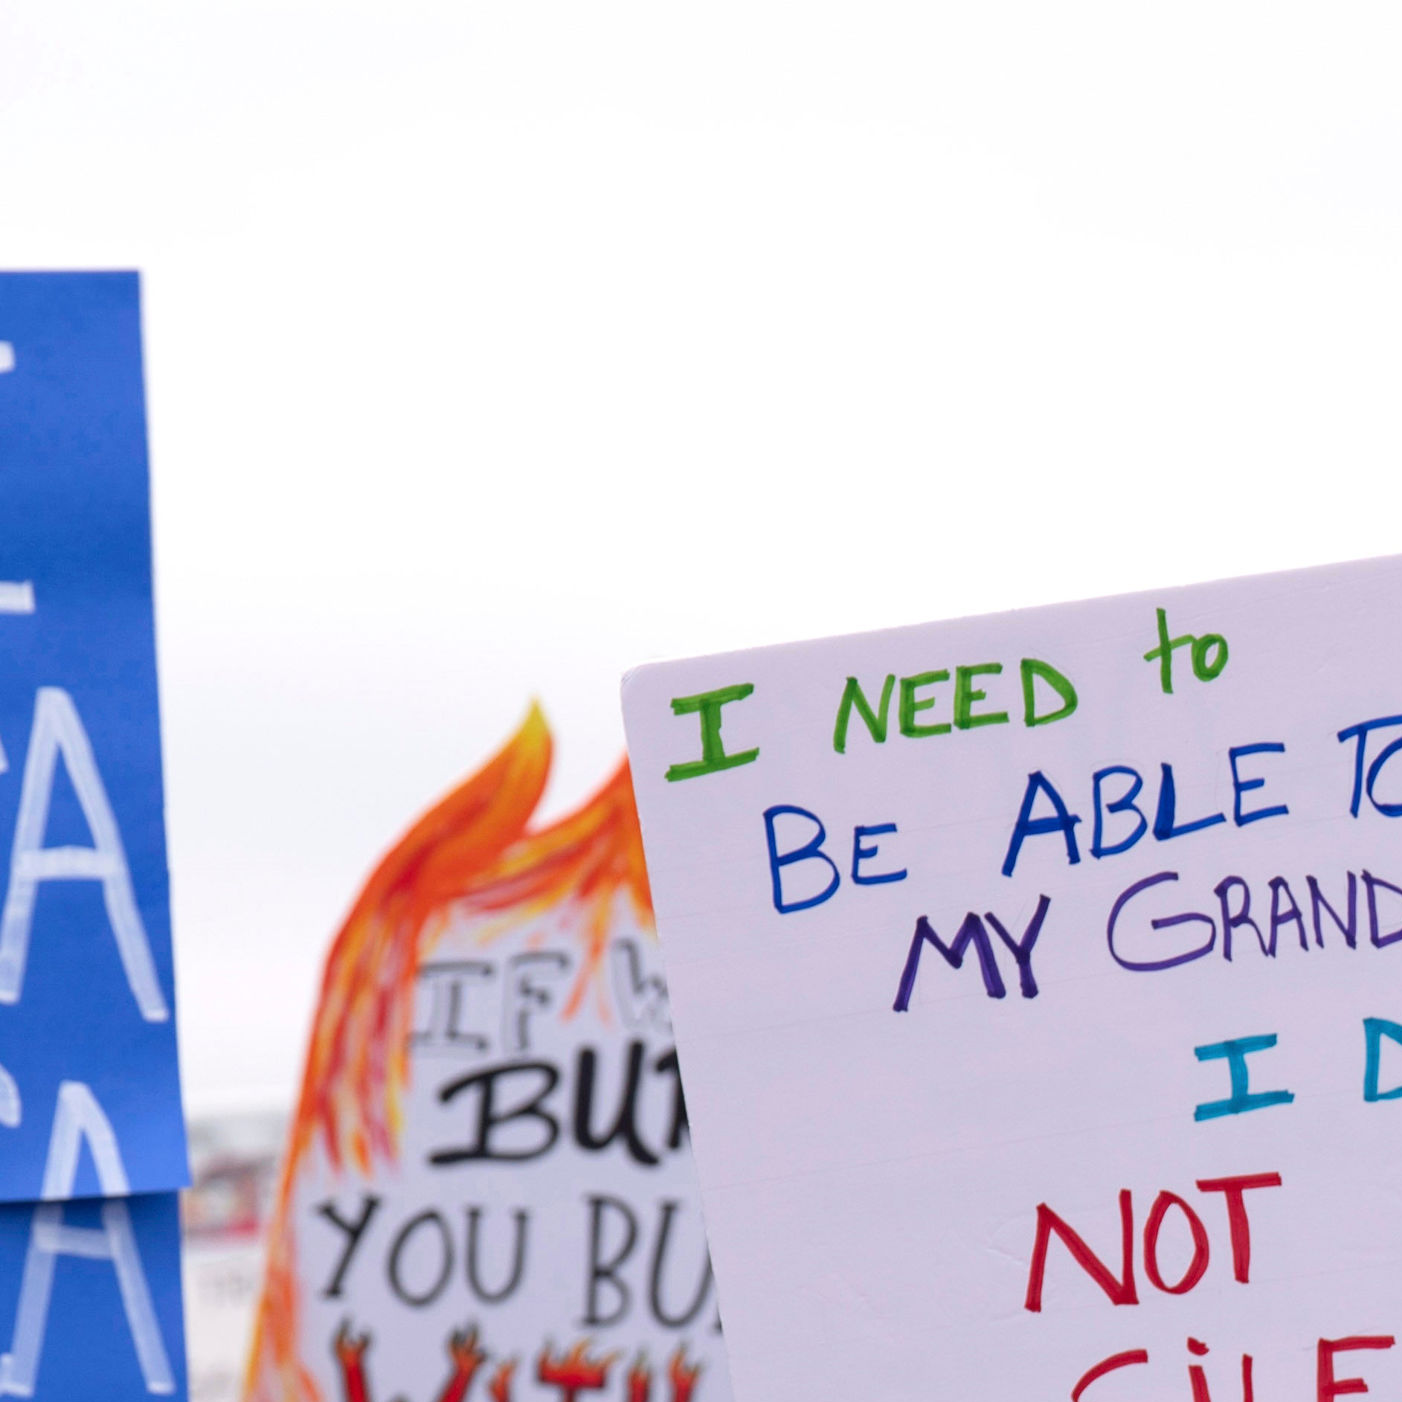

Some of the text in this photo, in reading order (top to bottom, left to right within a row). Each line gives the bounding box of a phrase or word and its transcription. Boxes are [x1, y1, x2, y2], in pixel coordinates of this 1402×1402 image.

[664, 607, 1229, 782] I NEED to
[763, 804, 907, 914] BE
[1002, 742, 1289, 877] ABLE
[415, 951, 570, 1053] IF
[892, 893, 1051, 1012] MY
[1194, 1033, 1294, 1121] I
[317, 1192, 531, 1305] YOU
[1025, 1172, 1281, 1312] NOT
